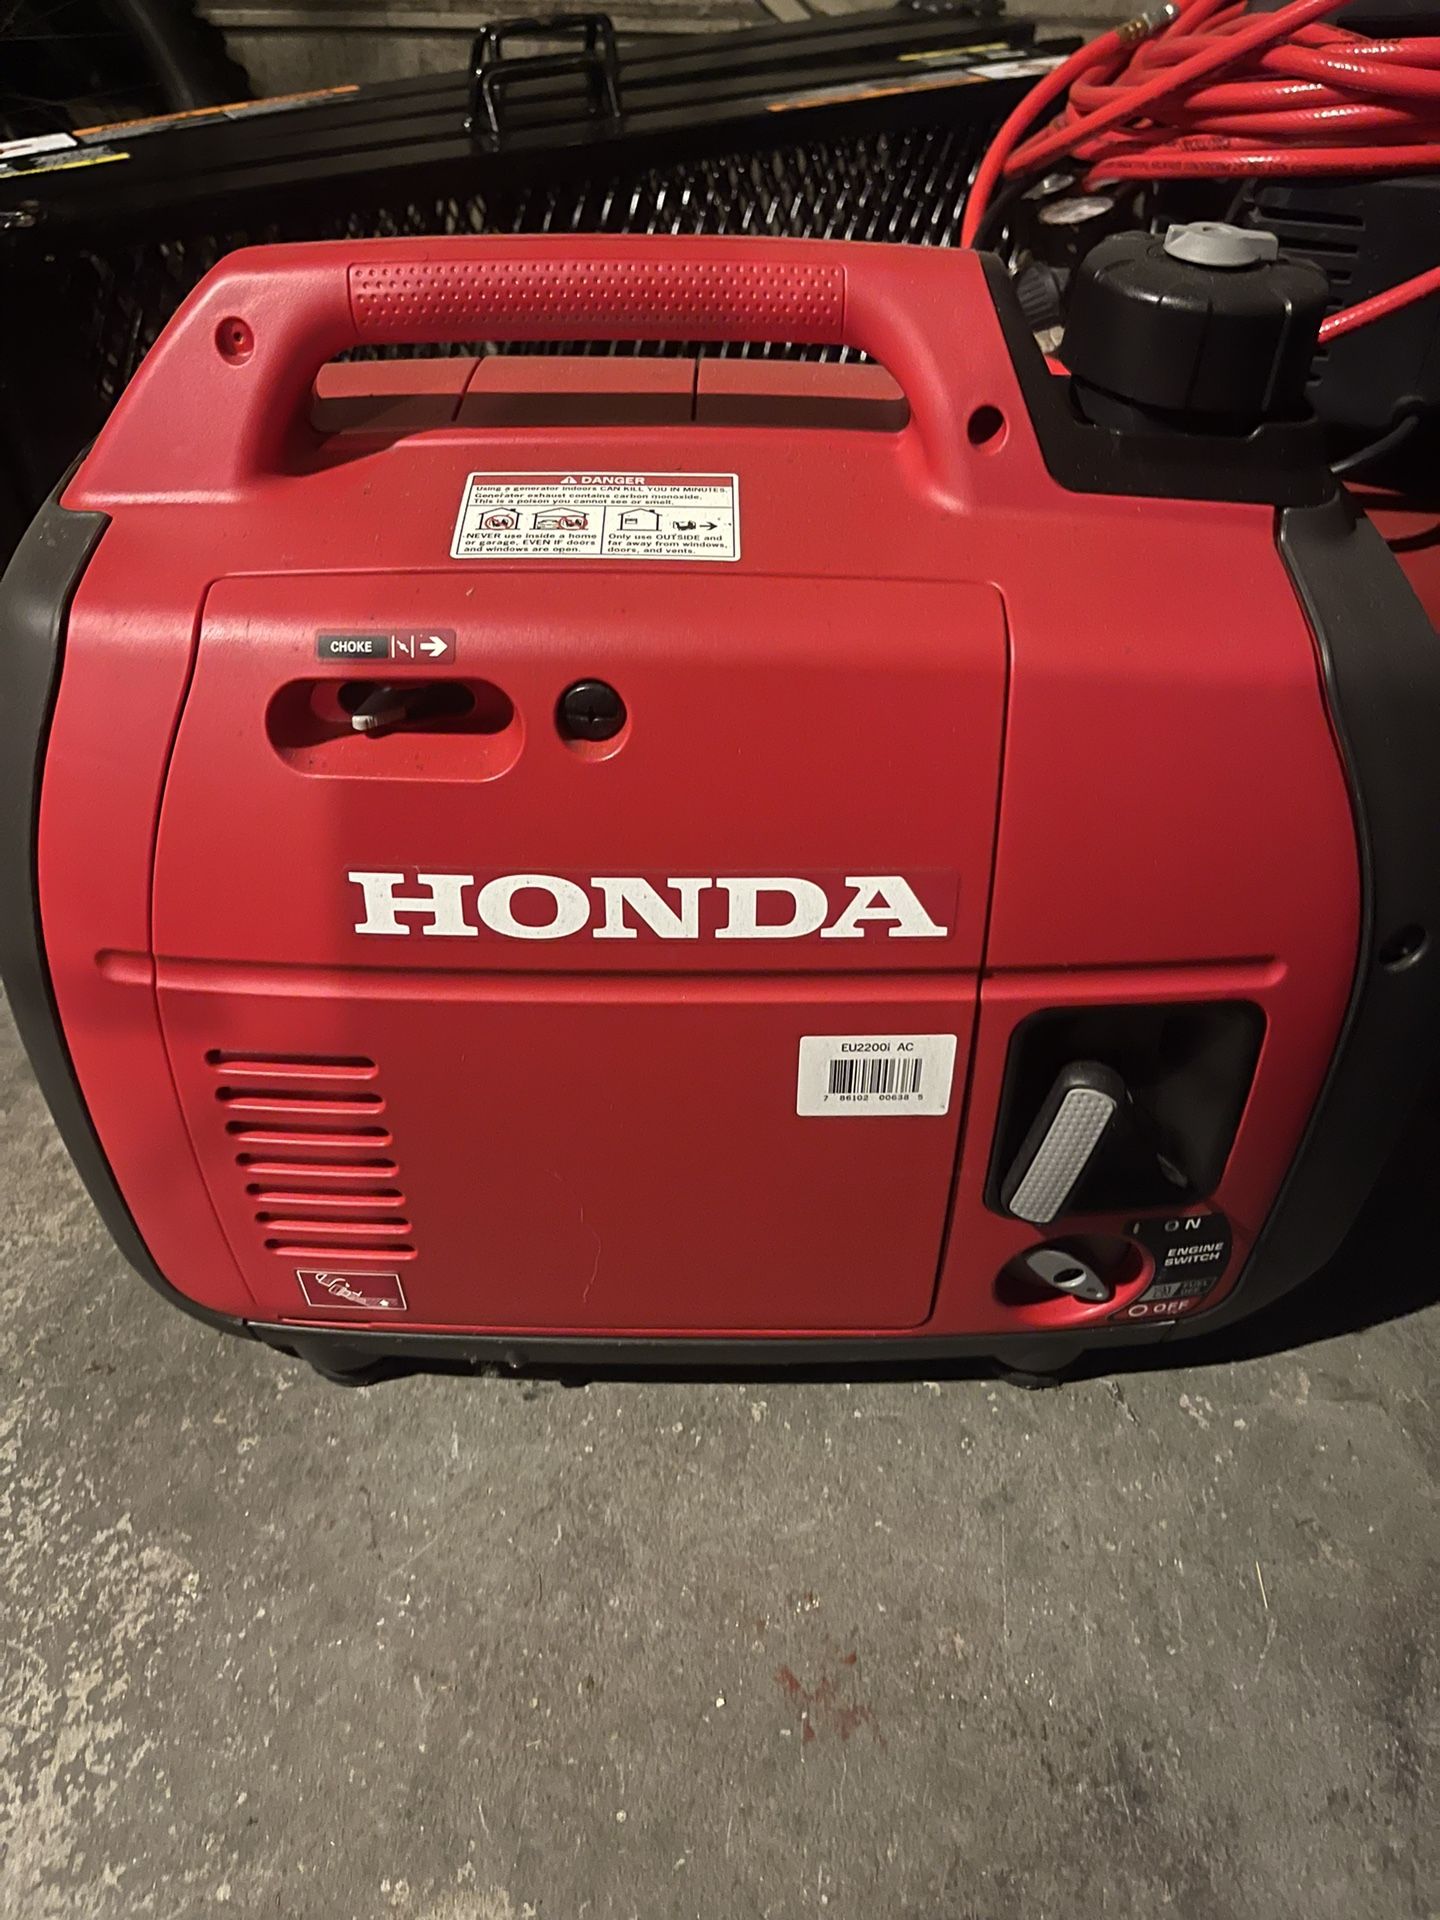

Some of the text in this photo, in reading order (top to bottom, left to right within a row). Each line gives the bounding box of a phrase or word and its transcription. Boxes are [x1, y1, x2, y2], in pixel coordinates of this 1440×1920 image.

[581, 476, 645, 485] DANGER
[608, 533, 631, 541] Only
[682, 541, 728, 549] windows,
[330, 641, 373, 653] CHOKE
[348, 872, 948, 940] HONDA
[841, 1042, 914, 1053] EU2200i AC
[1164, 1217, 1202, 1232] ON
[1167, 1242, 1224, 1257] ENGINE
[1164, 1252, 1220, 1267] SWITCH
[1152, 1299, 1190, 1313] OFF
